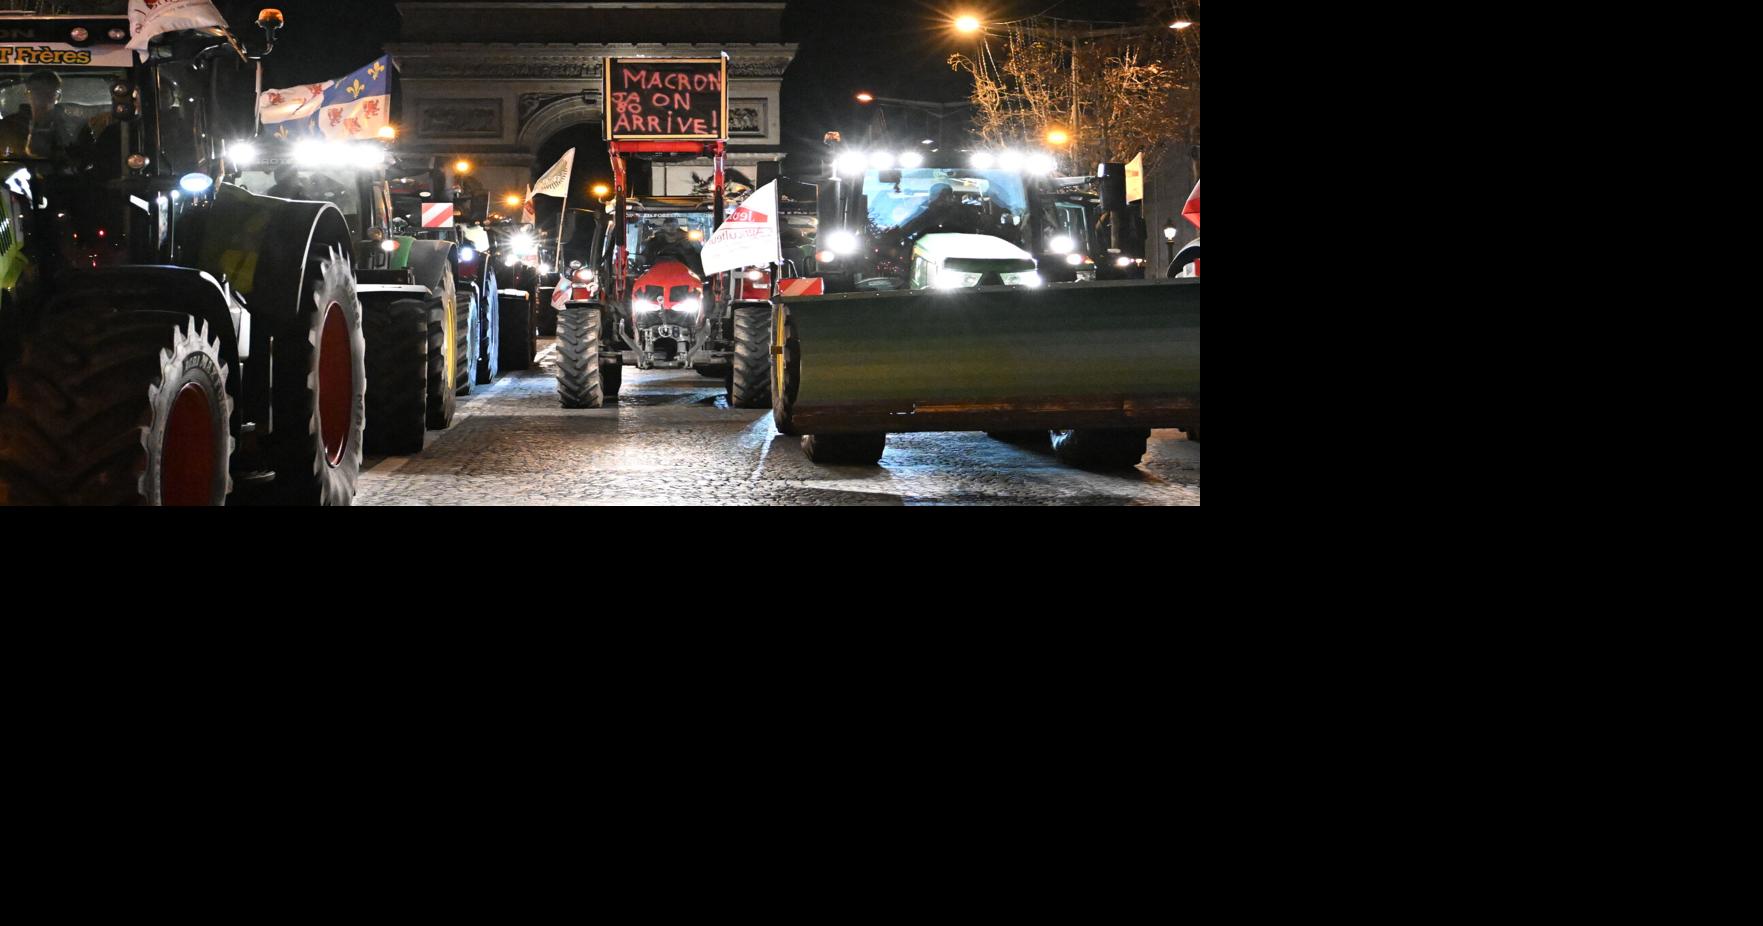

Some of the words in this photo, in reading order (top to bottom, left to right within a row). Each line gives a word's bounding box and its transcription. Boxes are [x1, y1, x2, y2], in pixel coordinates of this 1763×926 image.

[15, 46, 91, 64] Frères
[623, 68, 721, 91] MACRON
[651, 92, 690, 111] ON
